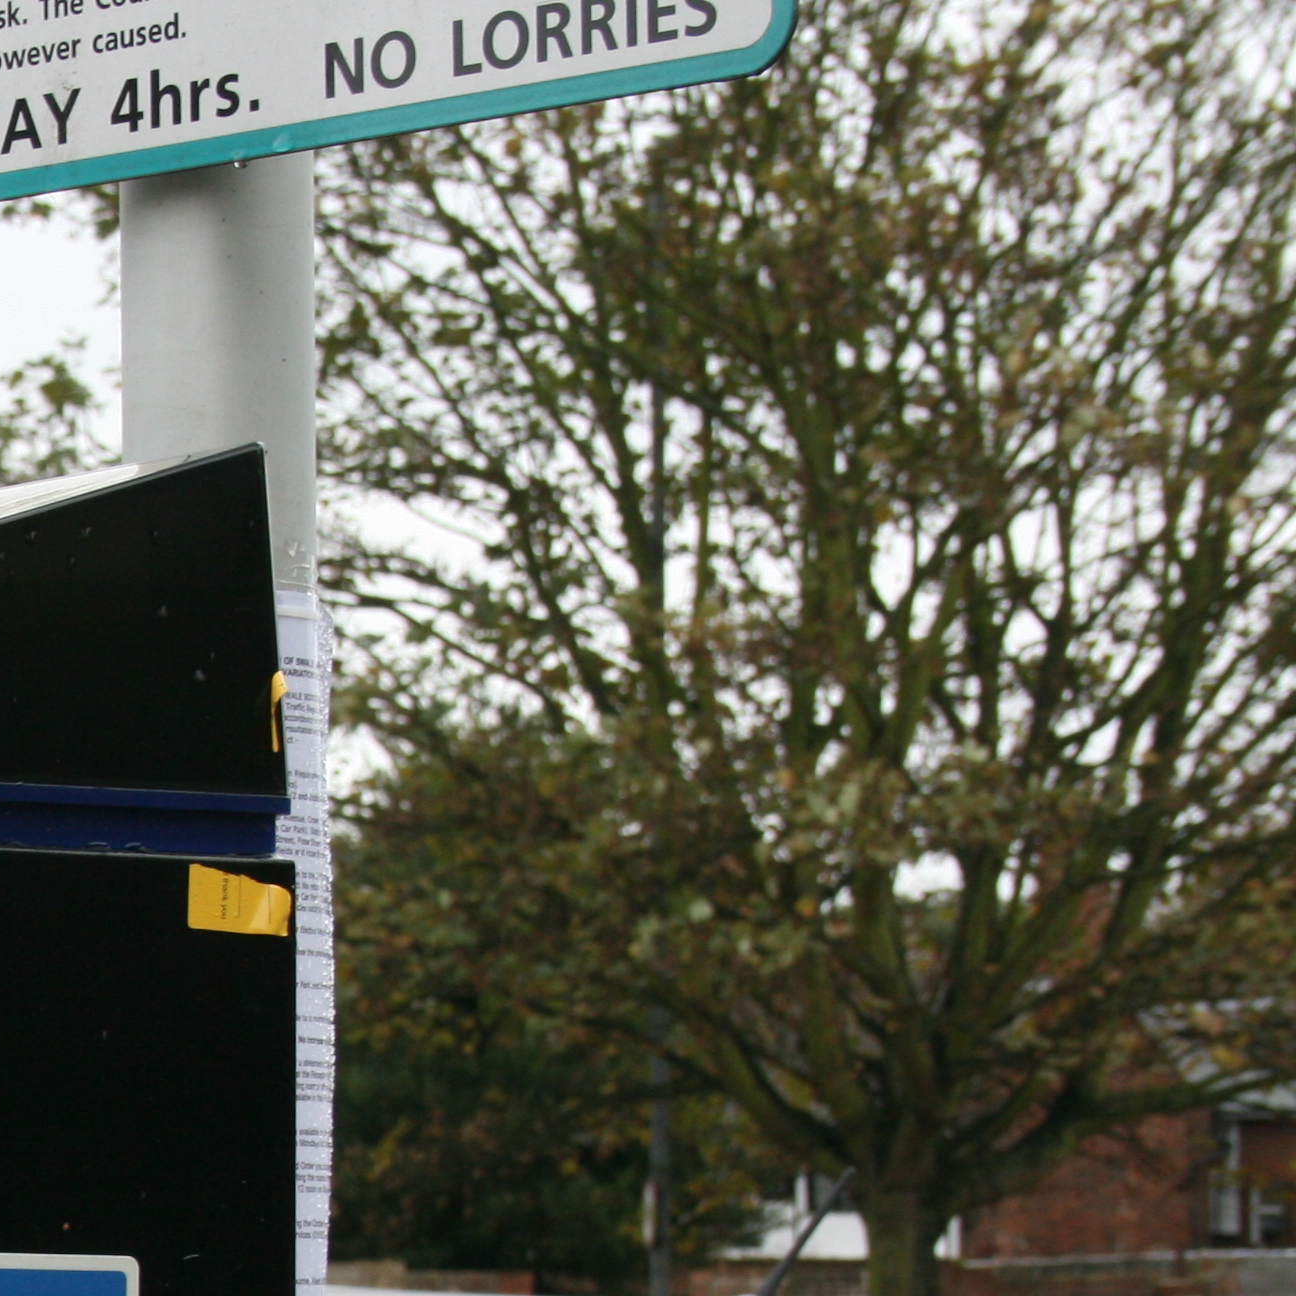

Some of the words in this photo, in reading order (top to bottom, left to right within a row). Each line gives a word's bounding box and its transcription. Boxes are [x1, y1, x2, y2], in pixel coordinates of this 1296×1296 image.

[38, 0, 83, 21] The
[92, 12, 187, 54] caused.
[324, 30, 417, 100] NO
[451, 0, 718, 78] LORRIES
[110, 68, 260, 133] 4hrs.
